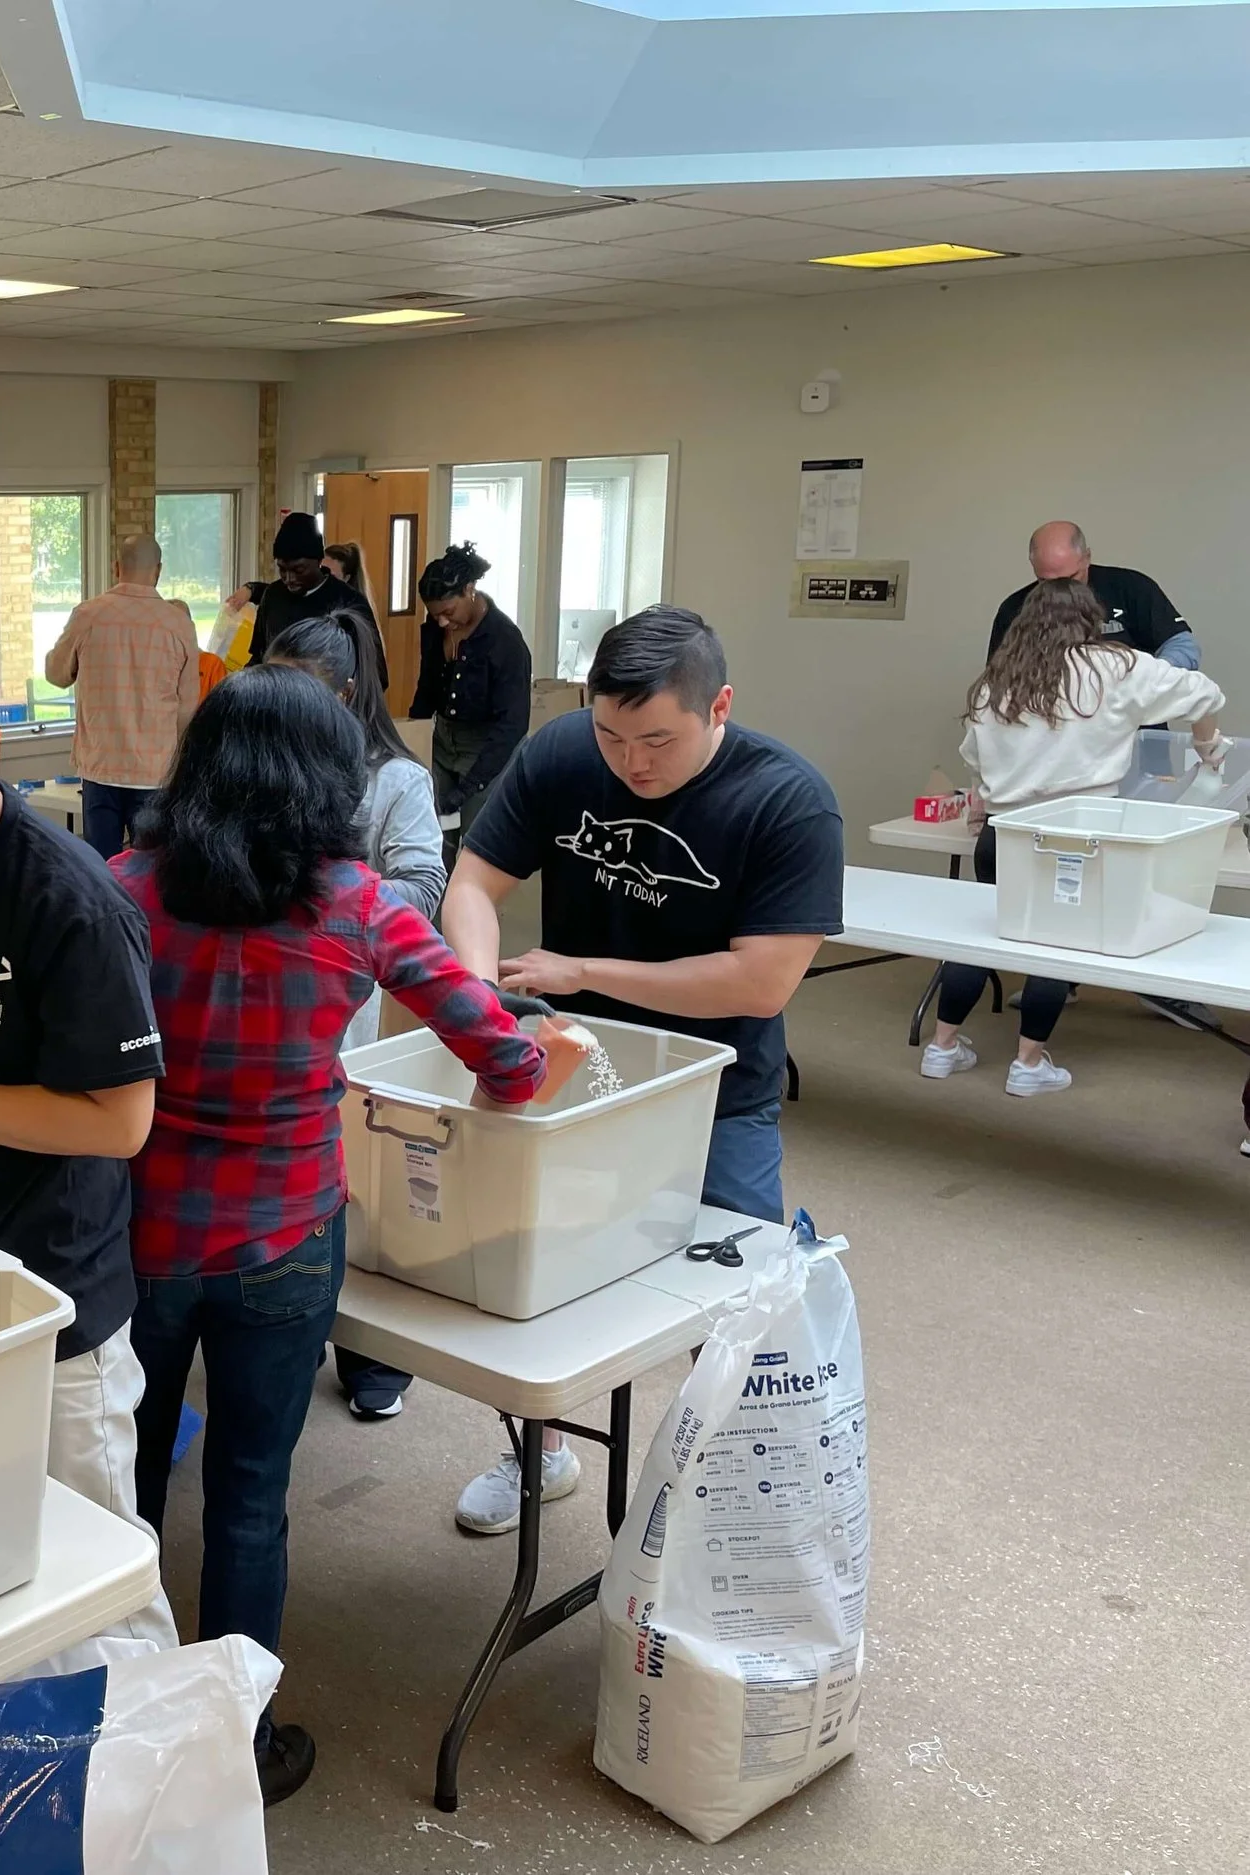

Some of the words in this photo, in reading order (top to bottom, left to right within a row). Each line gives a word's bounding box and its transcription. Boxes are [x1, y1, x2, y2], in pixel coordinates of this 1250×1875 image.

[595, 868, 618, 891] NT
[624, 880, 668, 908] TODAY
[741, 1371, 815, 1398] White
[674, 1424, 687, 1445] PESO
[681, 1406, 694, 1427] NETO
[727, 1426, 779, 1436] INSTRUCTIONS
[678, 1446, 691, 1461] LBS
[627, 1595, 638, 1620] rain
[711, 1609, 740, 1617] COOKING
[635, 1640, 647, 1675] Extra
[636, 1694, 651, 1765] RICELAND
